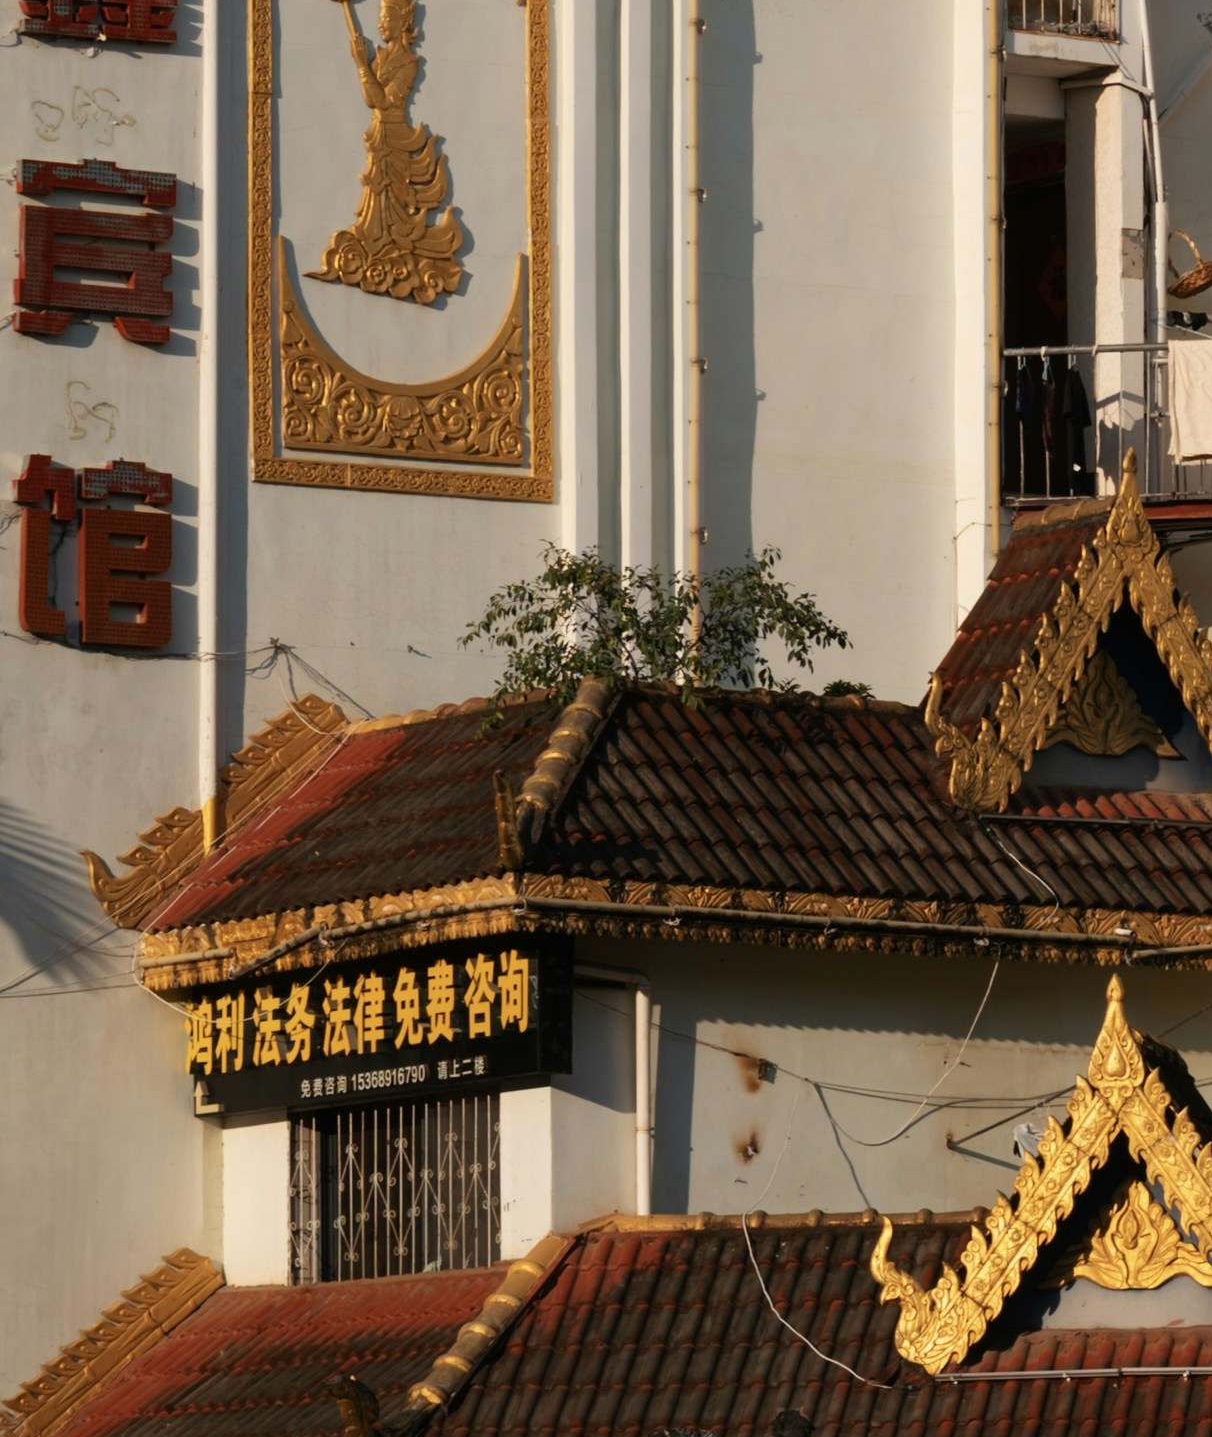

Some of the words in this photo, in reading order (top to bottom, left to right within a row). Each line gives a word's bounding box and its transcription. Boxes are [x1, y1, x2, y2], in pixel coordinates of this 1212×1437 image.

[300, 1075, 348, 1099] 免费咨询
[350, 1063, 426, 1092] 15368916790
[437, 1055, 487, 1080] 请上二楼
